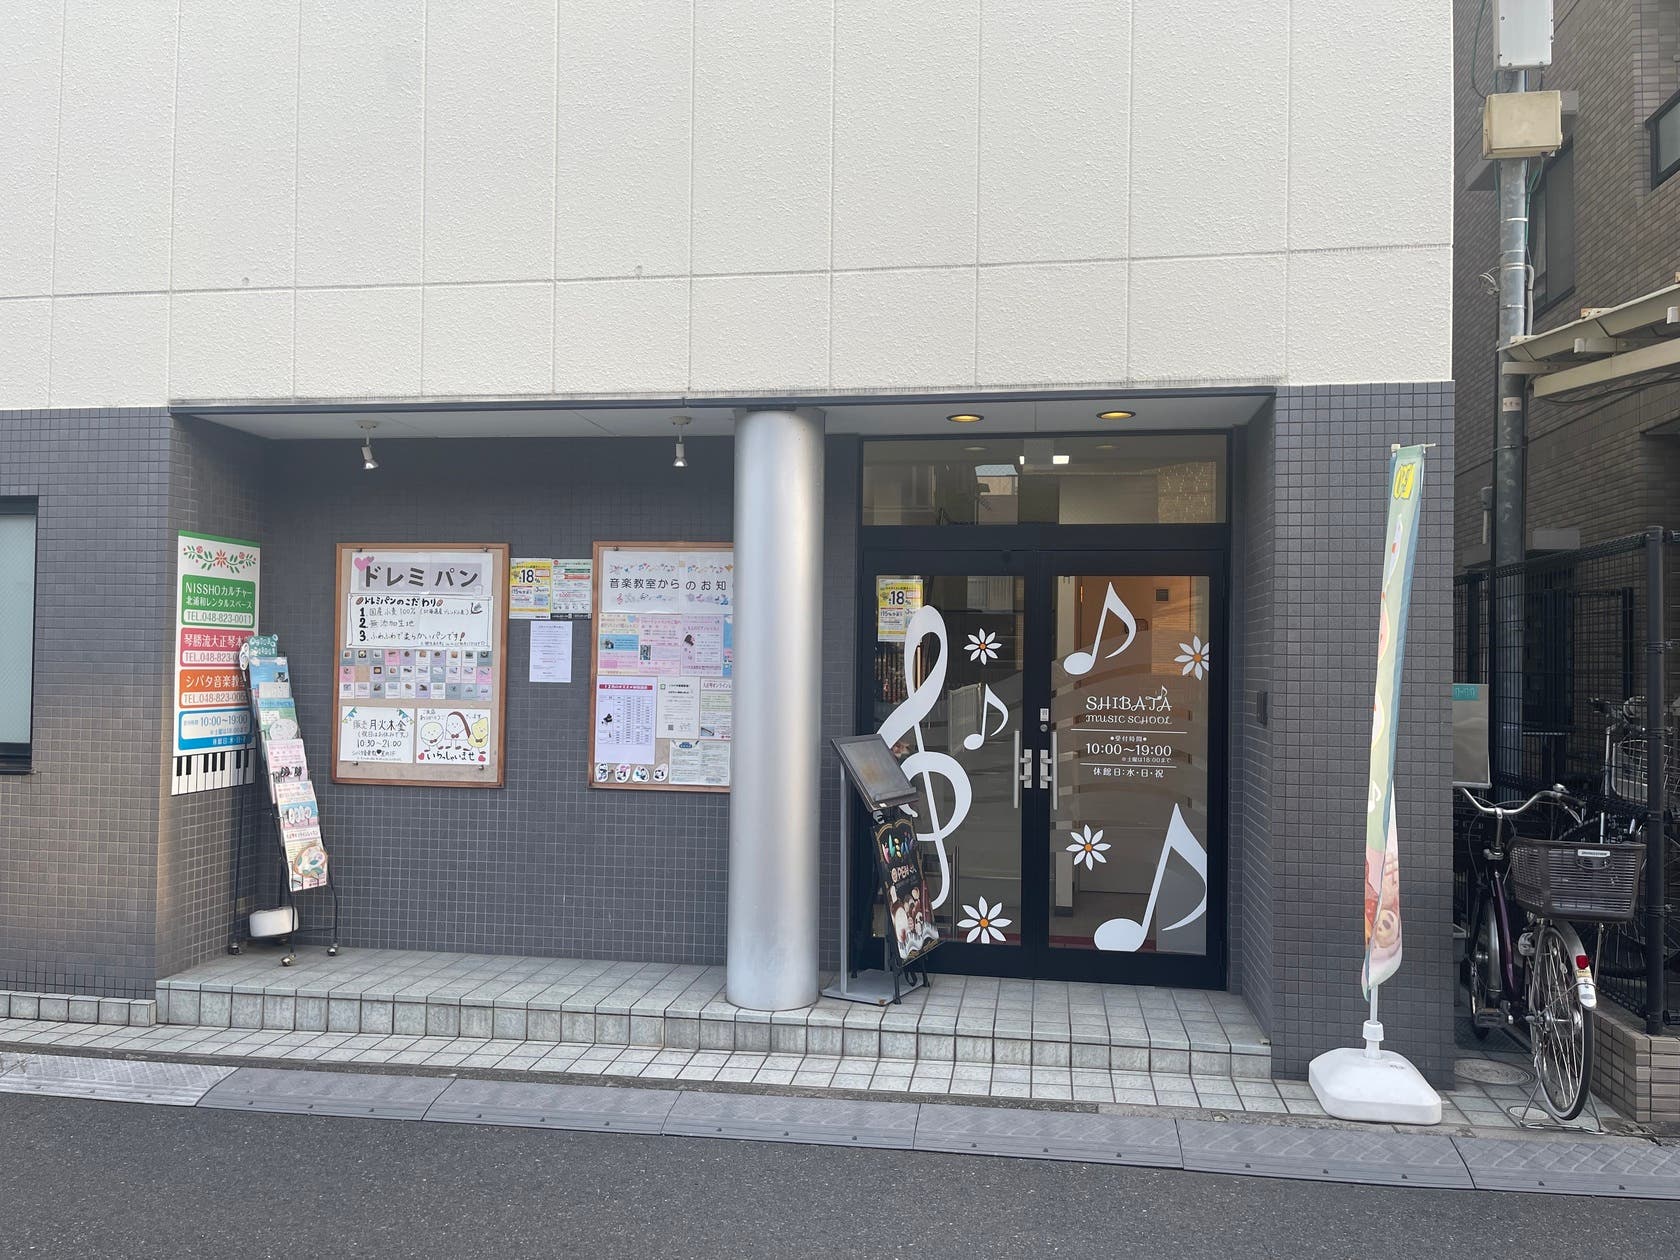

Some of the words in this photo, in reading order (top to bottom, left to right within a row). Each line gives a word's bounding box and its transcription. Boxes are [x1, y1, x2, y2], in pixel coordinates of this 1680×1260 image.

[365, 565, 479, 588] ドレミパン
[185, 582, 253, 599] NISSHOカルチャー
[185, 595, 253, 610] 北浦和レンタルスペース
[364, 597, 437, 608] ドレミパンのこだわり
[1085, 695, 1173, 712] SHIBATA
